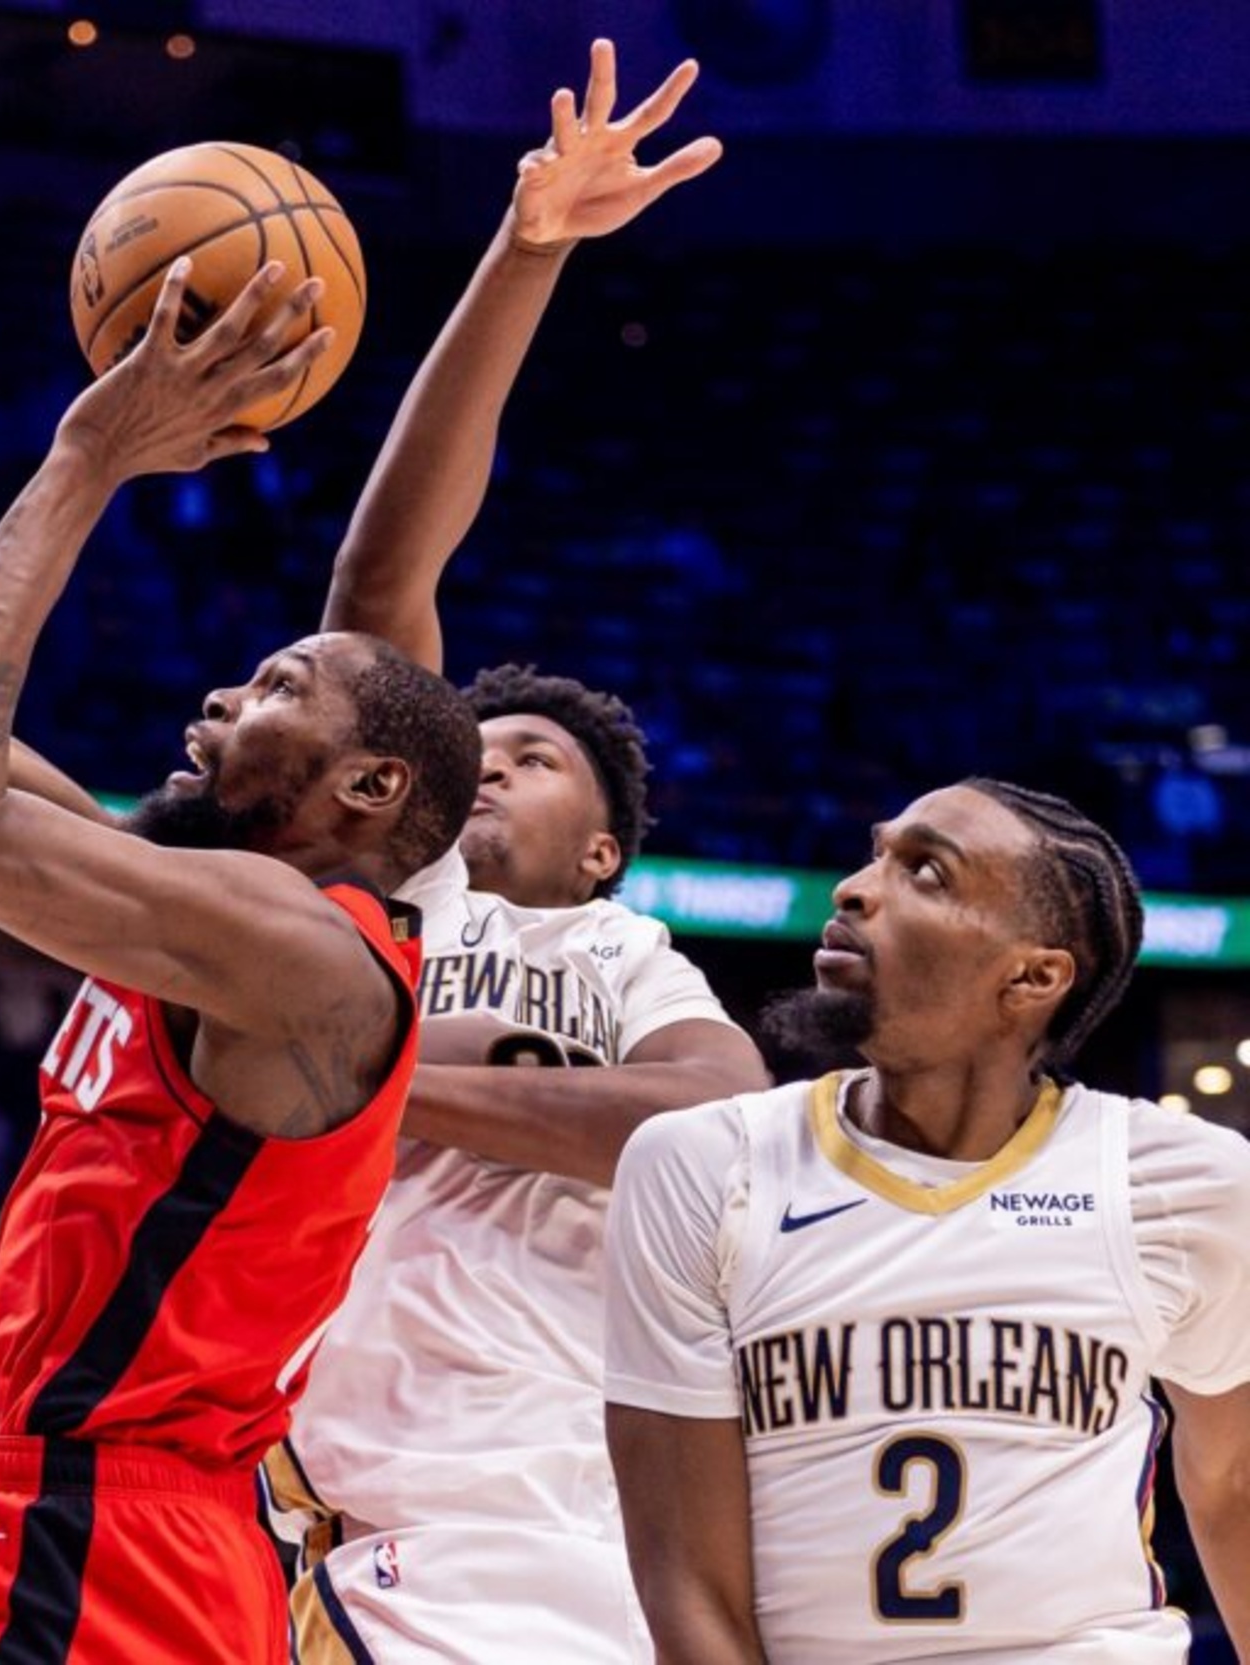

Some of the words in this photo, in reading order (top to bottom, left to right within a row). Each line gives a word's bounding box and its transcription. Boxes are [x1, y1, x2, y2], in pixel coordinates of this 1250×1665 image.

[990, 1193, 1095, 1212] NEWAGE
[1016, 1215, 1074, 1227] GRILLS
[738, 1320, 856, 1438] NEW
[879, 1317, 1128, 1436] ORLEANS
[871, 1430, 968, 1626] 2
